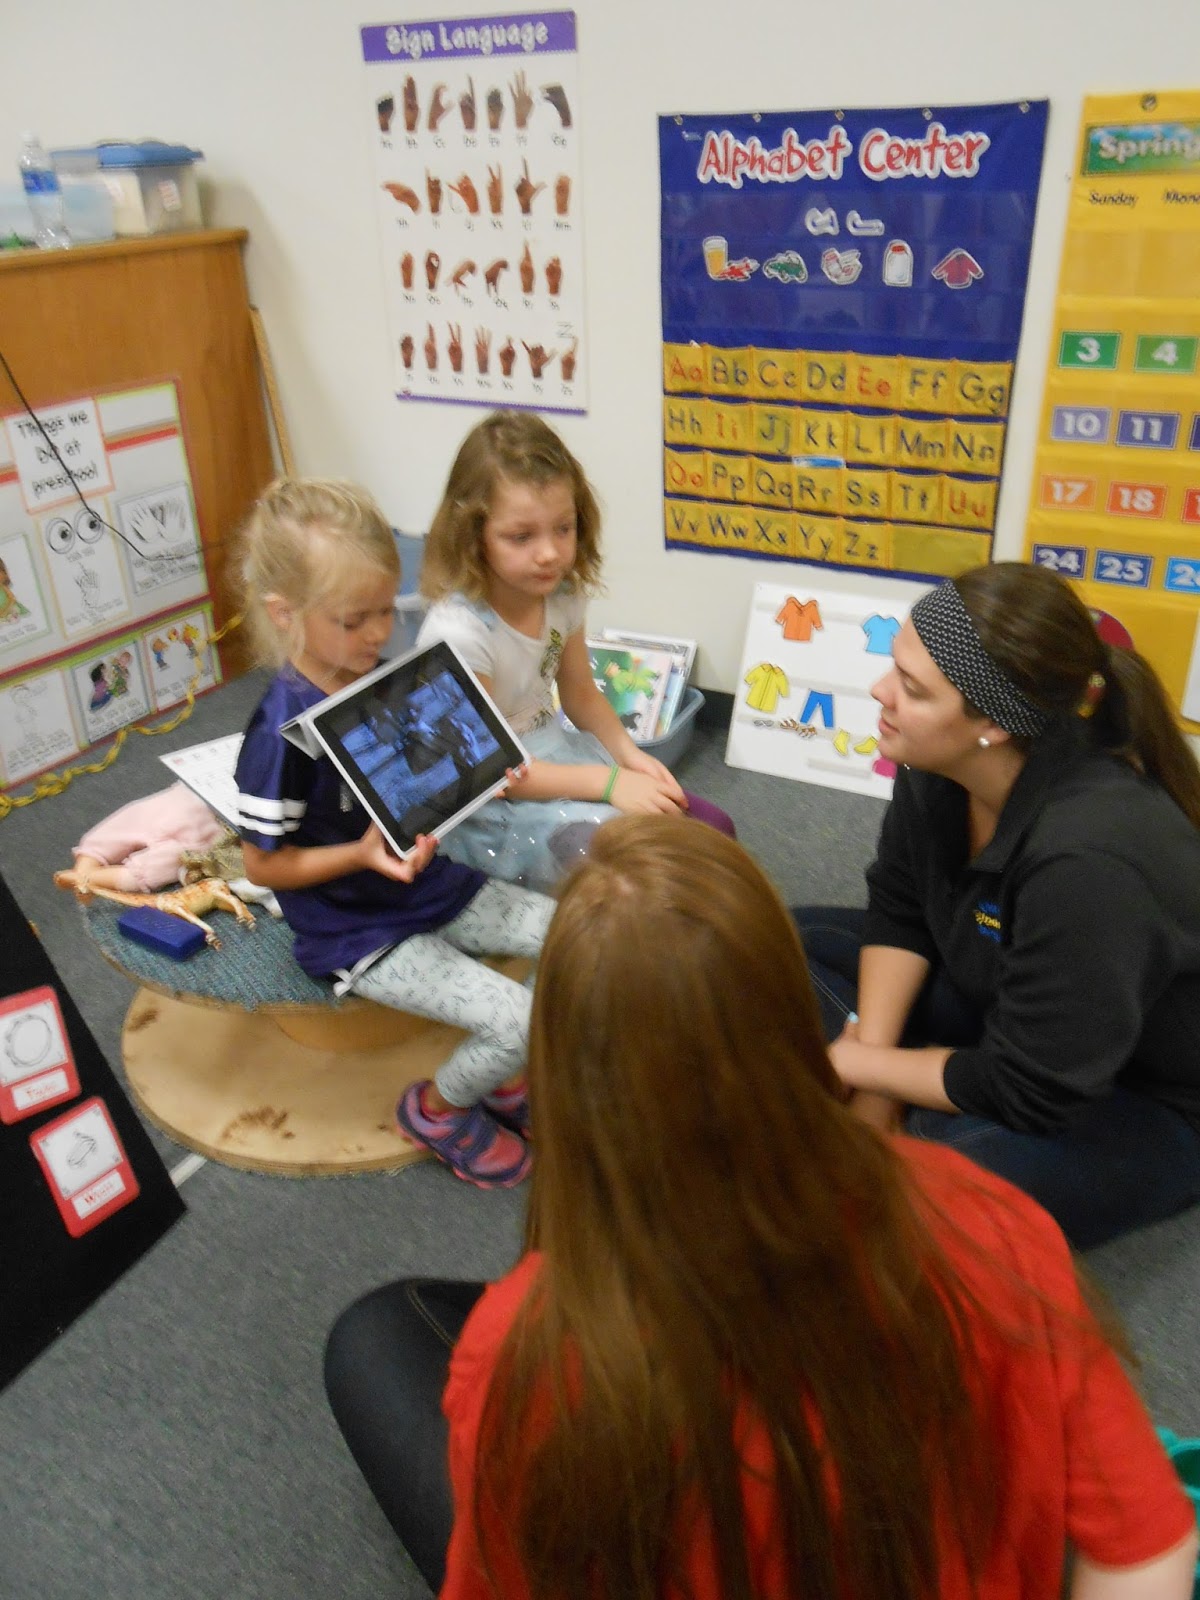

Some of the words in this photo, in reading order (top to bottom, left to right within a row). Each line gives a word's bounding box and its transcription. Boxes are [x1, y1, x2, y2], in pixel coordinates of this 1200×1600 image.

[386, 25, 435, 60] Sign
[438, 21, 549, 55] Language
[698, 125, 852, 189] Alphabet
[859, 122, 990, 181] Center
[1089, 190, 1138, 208] Sunday
[1076, 337, 1101, 362] 3
[1152, 341, 1179, 366] 4
[670, 356, 702, 381] Aa
[711, 356, 749, 386] Bb
[757, 360, 798, 389] Cc
[807, 361, 847, 391] Dd
[857, 366, 892, 396] Ee
[909, 368, 947, 399] Ff
[959, 373, 1004, 416] Gg
[668, 408, 702, 434] Hh
[759, 414, 790, 453] Jj
[805, 419, 837, 450] Kk
[899, 430, 947, 459] Mm
[954, 433, 996, 463] Nn
[1062, 411, 1101, 438] 10
[1131, 416, 1163, 442] 11
[712, 463, 746, 500] Pp
[756, 471, 793, 500] Qq
[799, 475, 832, 503] Rr
[846, 480, 881, 507] Ss
[899, 483, 928, 513] Tt
[949, 489, 987, 518] Uu
[1051, 480, 1088, 504] 17
[1118, 487, 1156, 512] 18
[670, 507, 700, 534] Vv
[708, 515, 749, 540] Ww
[755, 520, 789, 546] Xx
[799, 525, 833, 561] Yy
[845, 532, 879, 561] Zz
[1037, 548, 1081, 573] 24
[1099, 555, 1144, 582] 25
